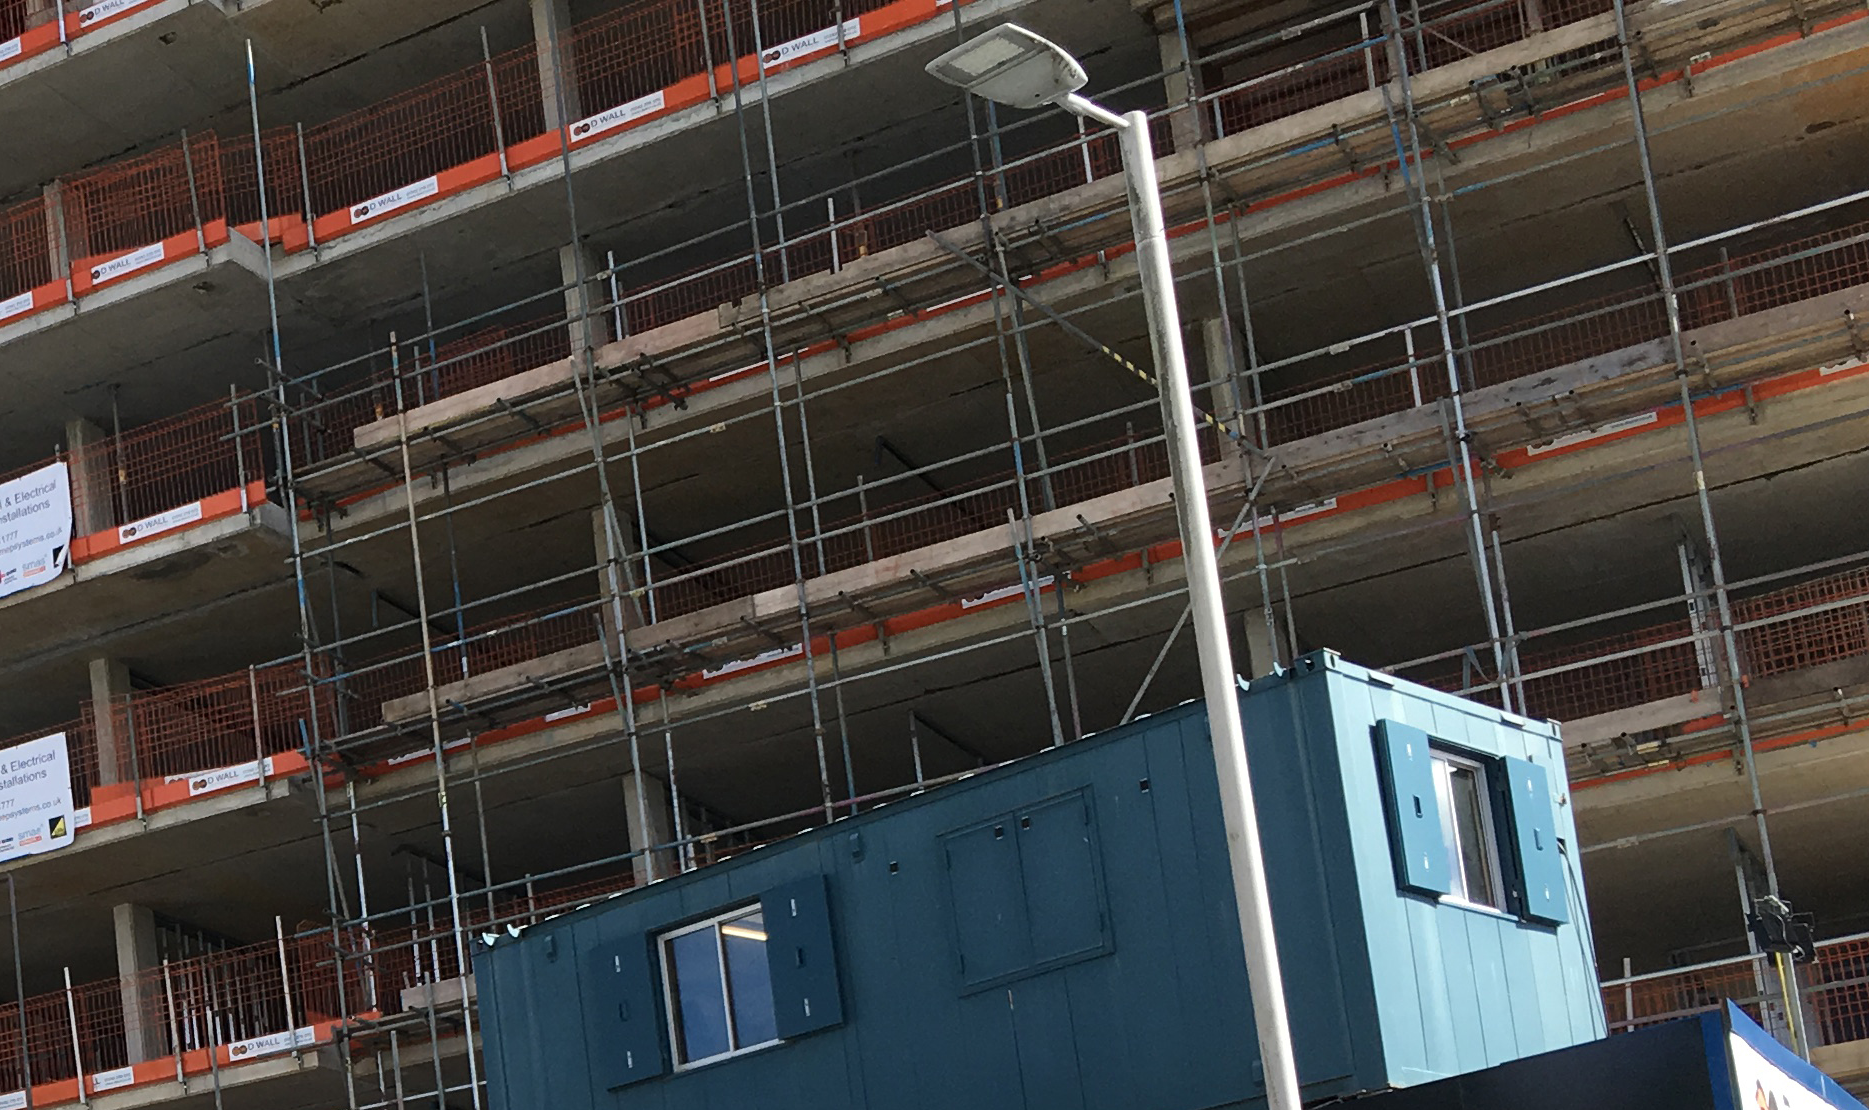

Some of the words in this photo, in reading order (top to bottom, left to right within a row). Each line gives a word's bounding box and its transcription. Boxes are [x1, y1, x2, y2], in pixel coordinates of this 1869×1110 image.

[791, 36, 818, 51] WALL
[600, 108, 625, 124] WALL
[378, 193, 401, 207] WALL
[108, 257, 131, 272] WALL
[5, 497, 11, 507] &
[15, 480, 56, 503] Electrical
[145, 515, 167, 529] WALL
[1, 764, 8, 774] &
[11, 750, 55, 772] Electrical
[216, 769, 238, 782] WALL
[256, 1037, 279, 1049] WALL
